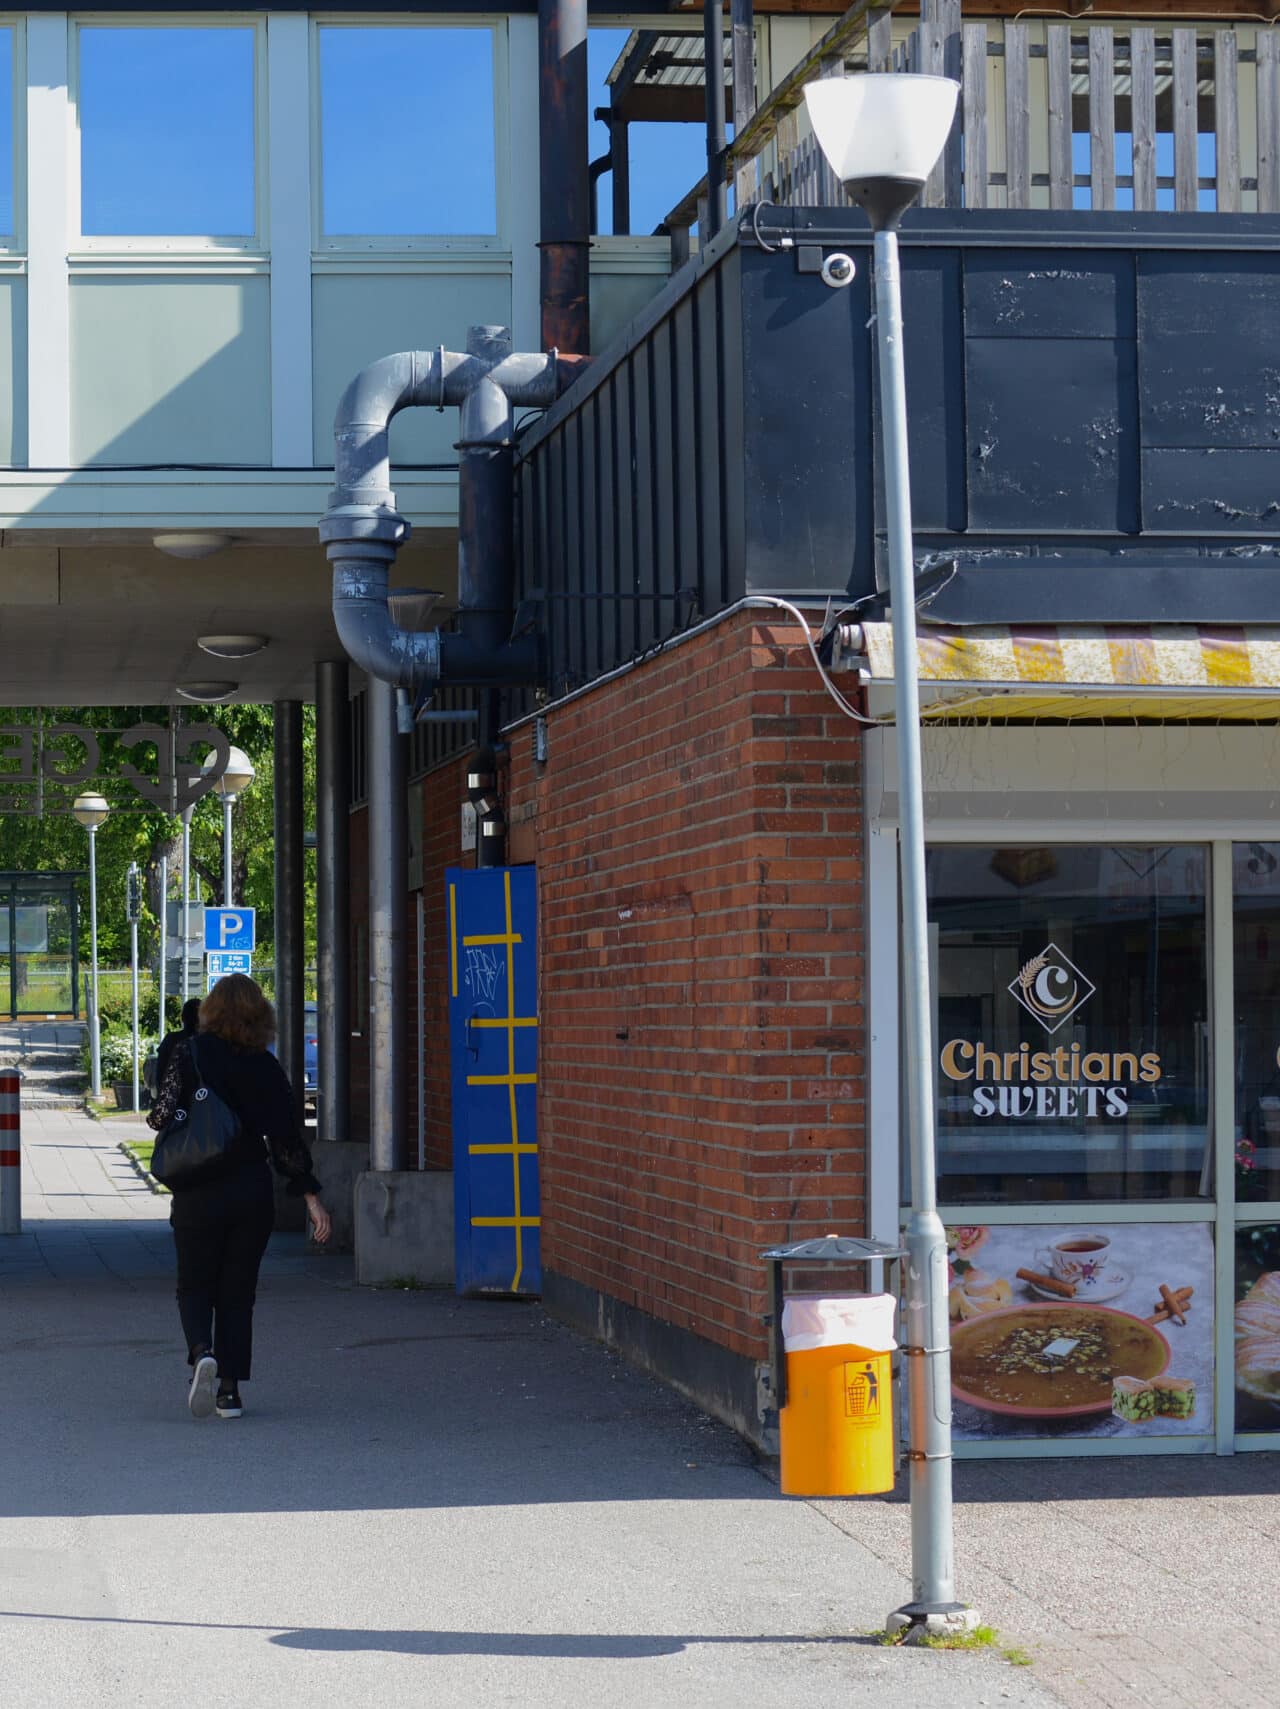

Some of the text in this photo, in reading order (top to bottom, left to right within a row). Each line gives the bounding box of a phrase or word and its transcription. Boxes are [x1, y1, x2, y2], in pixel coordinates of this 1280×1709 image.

[220, 913, 243, 947] P
[940, 1038, 1161, 1082] Christians
[972, 1086, 1129, 1118] SWEETS
